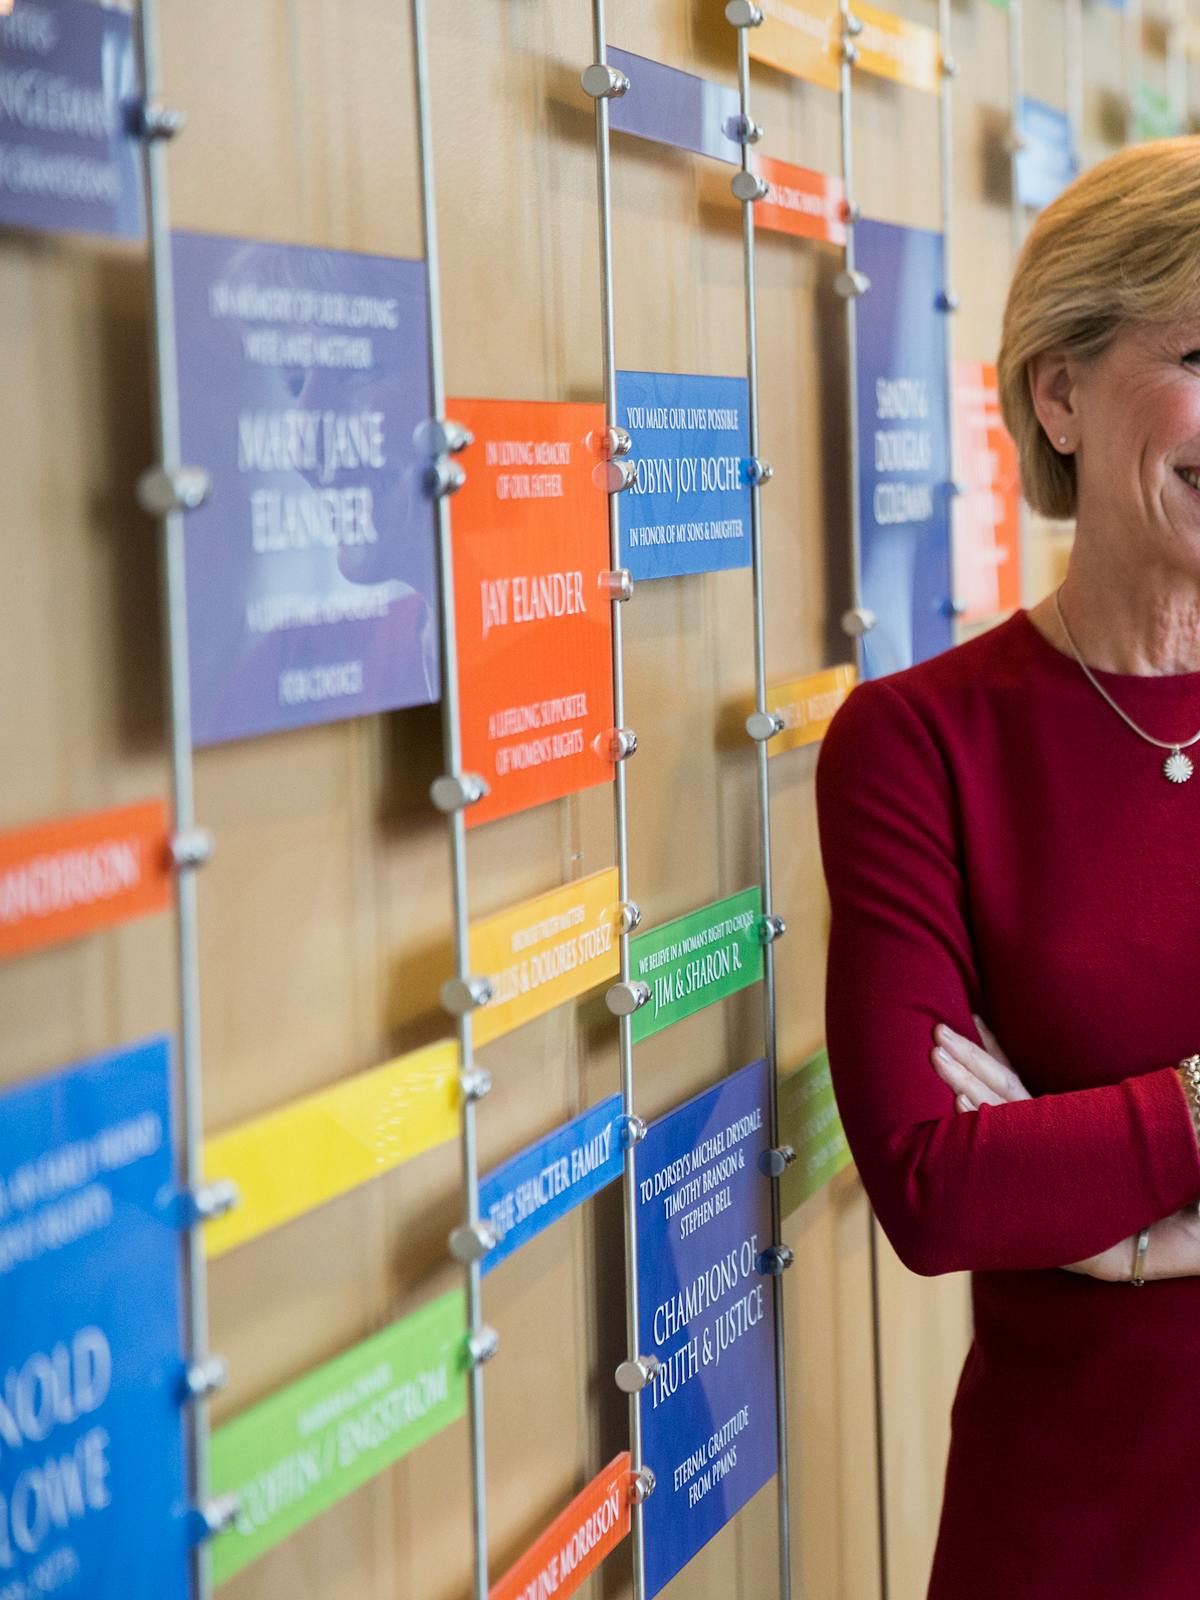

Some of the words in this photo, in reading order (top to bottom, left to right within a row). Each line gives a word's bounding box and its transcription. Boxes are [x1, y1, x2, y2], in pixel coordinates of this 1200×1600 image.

[237, 409, 318, 473] MARY
[317, 409, 386, 486] JANE
[627, 408, 644, 429] YOU
[646, 408, 668, 430] MADE
[670, 408, 687, 430] OUR
[687, 408, 706, 431] LIVES
[707, 409, 739, 431] POSSIBLE
[535, 440, 571, 466] MEMORY
[628, 458, 672, 495] ROBYN
[675, 457, 698, 503] JOY
[700, 456, 742, 492] BOCHE
[531, 473, 565, 498] FATHER
[630, 527, 638, 547] IN
[640, 526, 666, 546] HONOR
[666, 525, 675, 543] OF
[677, 524, 687, 543] MY
[687, 522, 704, 542] SONS
[704, 521, 711, 540] &
[711, 519, 744, 540] DAUGHTER
[480, 576, 511, 641] JAY
[512, 570, 586, 623] ELANDER
[497, 700, 541, 735] LIFELONG
[542, 692, 588, 731] SUPPORTER
[552, 728, 584, 760] RIGHTS
[578, 922, 612, 966] STOESZ
[639, 957, 649, 975] WE
[649, 947, 670, 971] BELIEVE
[670, 943, 678, 961] IN
[678, 943, 683, 957] A
[682, 930, 708, 954] WOMAN'S
[708, 922, 725, 943] RIGHT
[725, 919, 733, 935] TO
[733, 909, 754, 931] CHOOSE
[653, 973, 675, 1020] JIM
[675, 968, 685, 999] &
[686, 947, 730, 995] SHARON
[571, 1122, 613, 1183] FAMILY
[640, 1178, 653, 1205] TO
[654, 1153, 690, 1196] DORSEY'S
[691, 1131, 726, 1172] MICHAEL
[726, 1108, 763, 1148] DRYSDALE
[664, 1175, 701, 1220] TIMOTHY
[702, 1152, 738, 1194] BRANSON
[738, 1148, 745, 1169] &
[680, 1197, 714, 1240] STEPHEN
[715, 1186, 732, 1215] BELL
[653, 1250, 738, 1346] CHAMPIONS
[740, 1234, 758, 1278] OF
[651, 1336, 699, 1410] TRUTH
[702, 1327, 714, 1366] &
[715, 1284, 764, 1367] JUSTICE
[674, 1444, 708, 1492] ETERNAL
[708, 1405, 749, 1458] GRATITUDE
[688, 1470, 712, 1509] FROM
[712, 1445, 737, 1486] PPMNS
[560, 1488, 620, 1583] MORRISON
